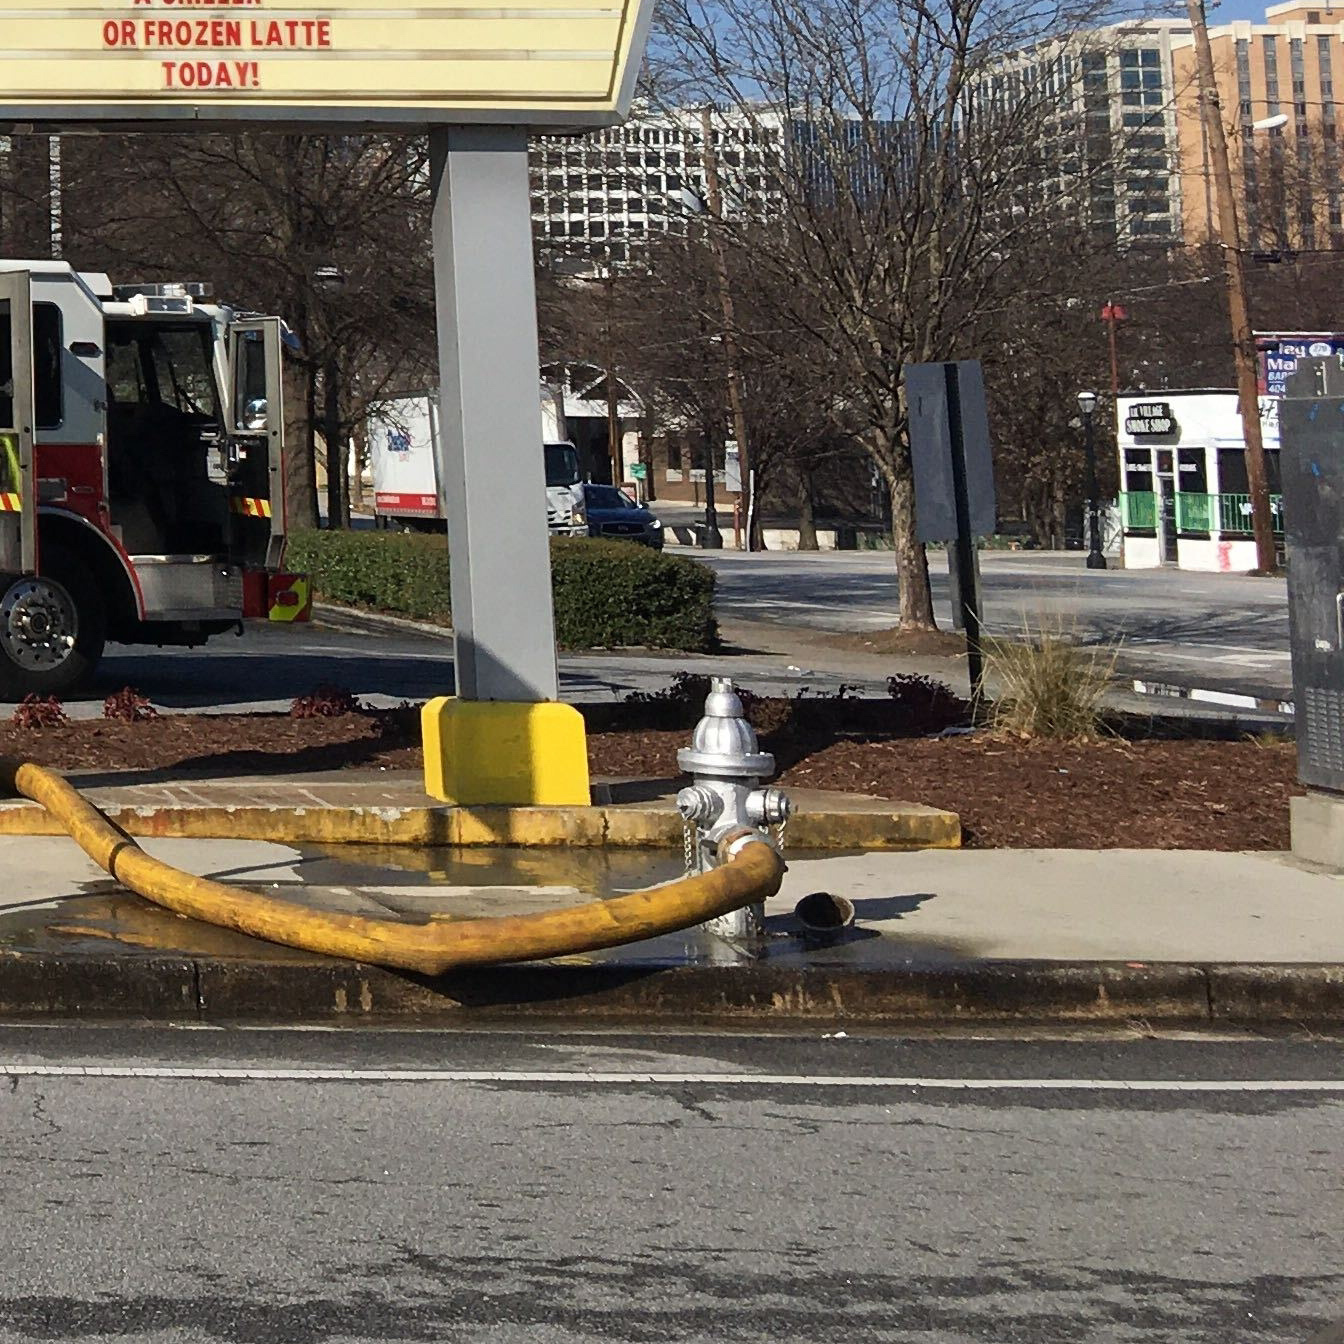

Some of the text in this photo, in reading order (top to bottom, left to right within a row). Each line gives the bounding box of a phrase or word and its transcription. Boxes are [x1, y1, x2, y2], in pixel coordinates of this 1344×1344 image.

[103, 20, 331, 46] OR FROZEN LATTE
[161, 62, 260, 87] TODAY!
